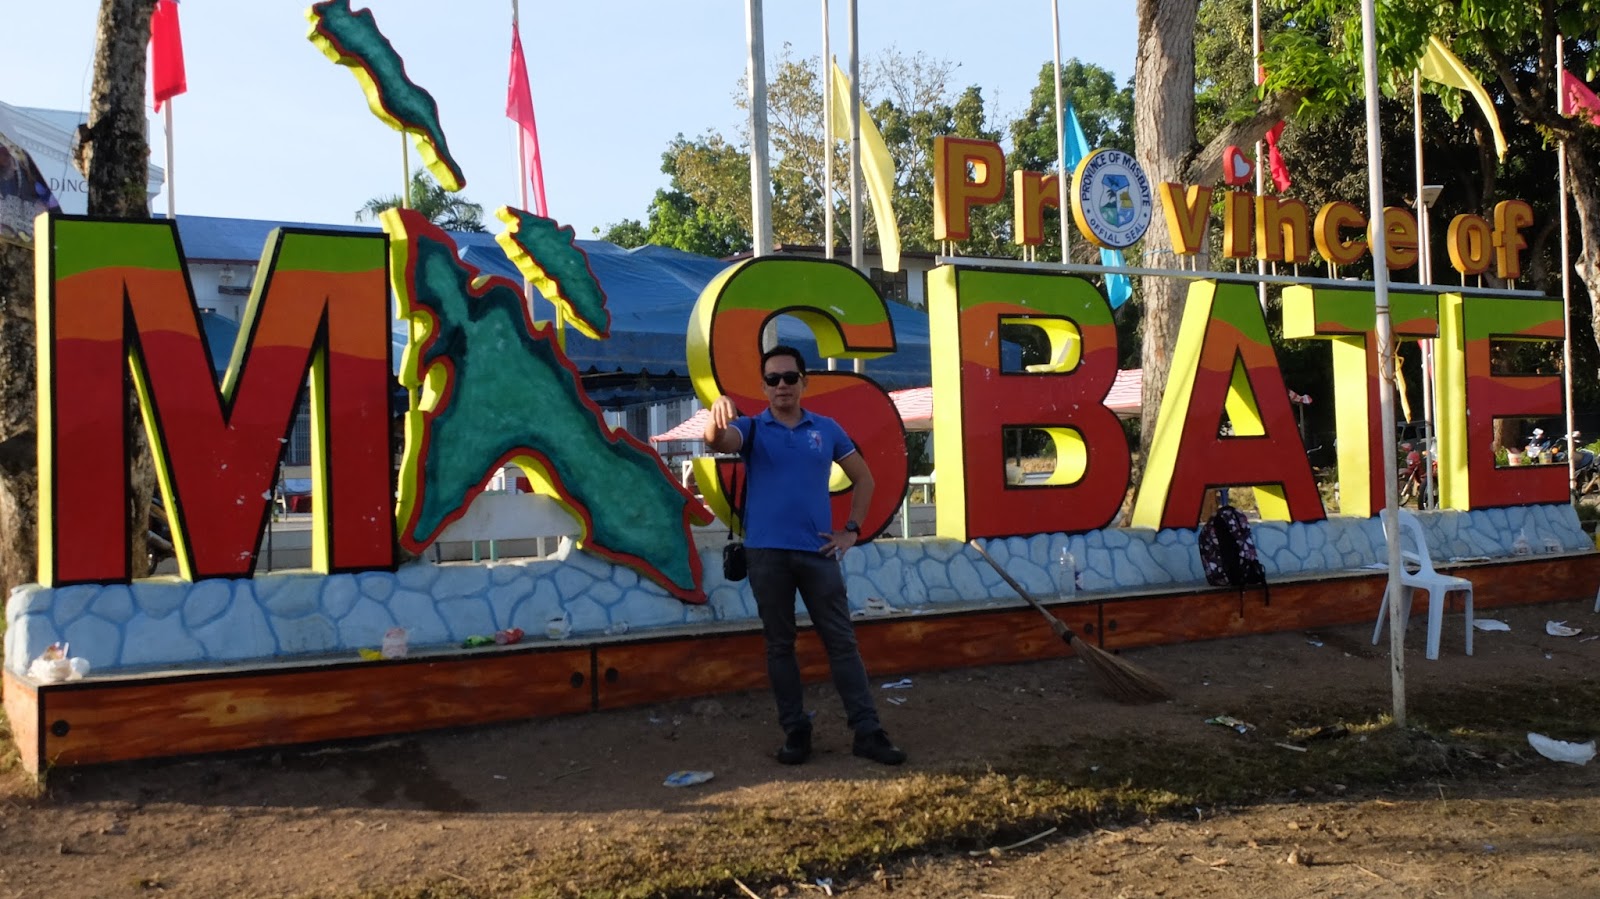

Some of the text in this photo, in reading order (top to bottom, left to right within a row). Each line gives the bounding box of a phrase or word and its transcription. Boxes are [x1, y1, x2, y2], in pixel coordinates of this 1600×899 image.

[1082, 152, 1151, 207] PROVINCE OF MASBATE
[1125, 223, 1145, 242] SEAL
[1448, 199, 1534, 279] of
